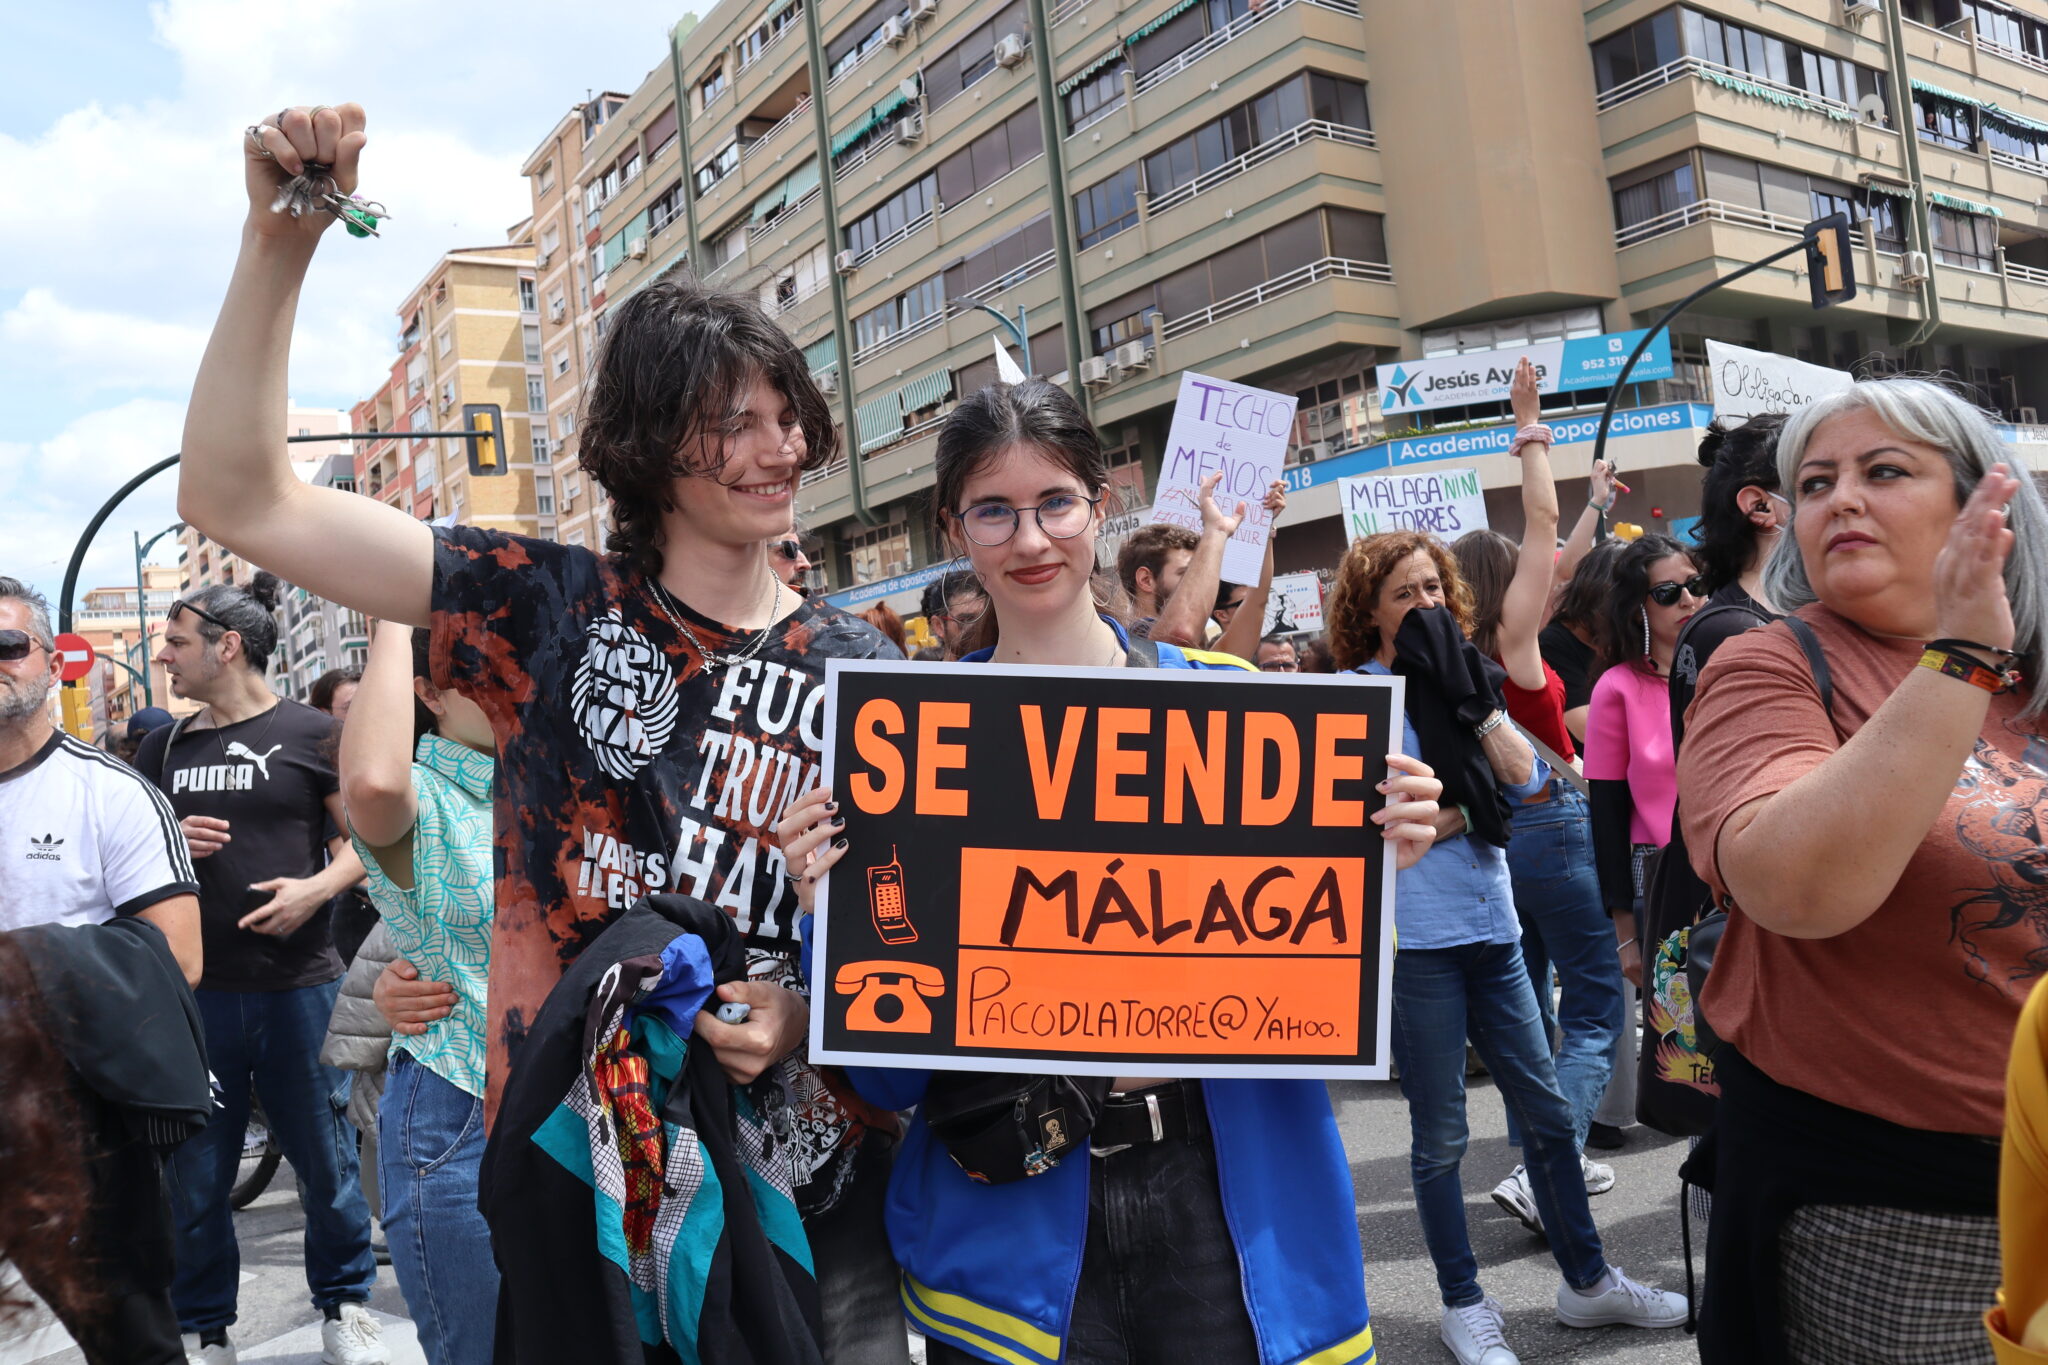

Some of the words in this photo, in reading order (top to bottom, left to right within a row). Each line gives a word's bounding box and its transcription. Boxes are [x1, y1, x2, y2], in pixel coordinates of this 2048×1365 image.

[1424, 370, 1480, 392] Jesús
[1485, 361, 1547, 385] Aya
[1582, 358, 1605, 370] 952
[1608, 355, 1629, 367] 319
[1192, 381, 1292, 437] TECHO
[1433, 391, 1475, 402] ACADEMIA
[1216, 432, 1232, 451] de
[1554, 411, 1681, 442] opociones
[1400, 431, 1510, 459] Academia
[1170, 446, 1272, 501] MENOS
[1283, 467, 1312, 492] 618
[1351, 478, 1442, 510] MÁLAGA
[1107, 514, 1140, 536] Ayala
[1352, 512, 1378, 535] NI
[1388, 505, 1461, 533] TORRES
[849, 582, 887, 602] Academia
[888, 577, 899, 592] de
[711, 654, 825, 752] FUC
[849, 698, 971, 817] SE
[1020, 704, 1368, 827] VENDE
[173, 764, 253, 794] PUMA
[690, 728, 821, 833] TRUM
[26, 852, 61, 861] adidas
[671, 816, 801, 942] HAT
[999, 857, 1347, 947] MÁLAGA
